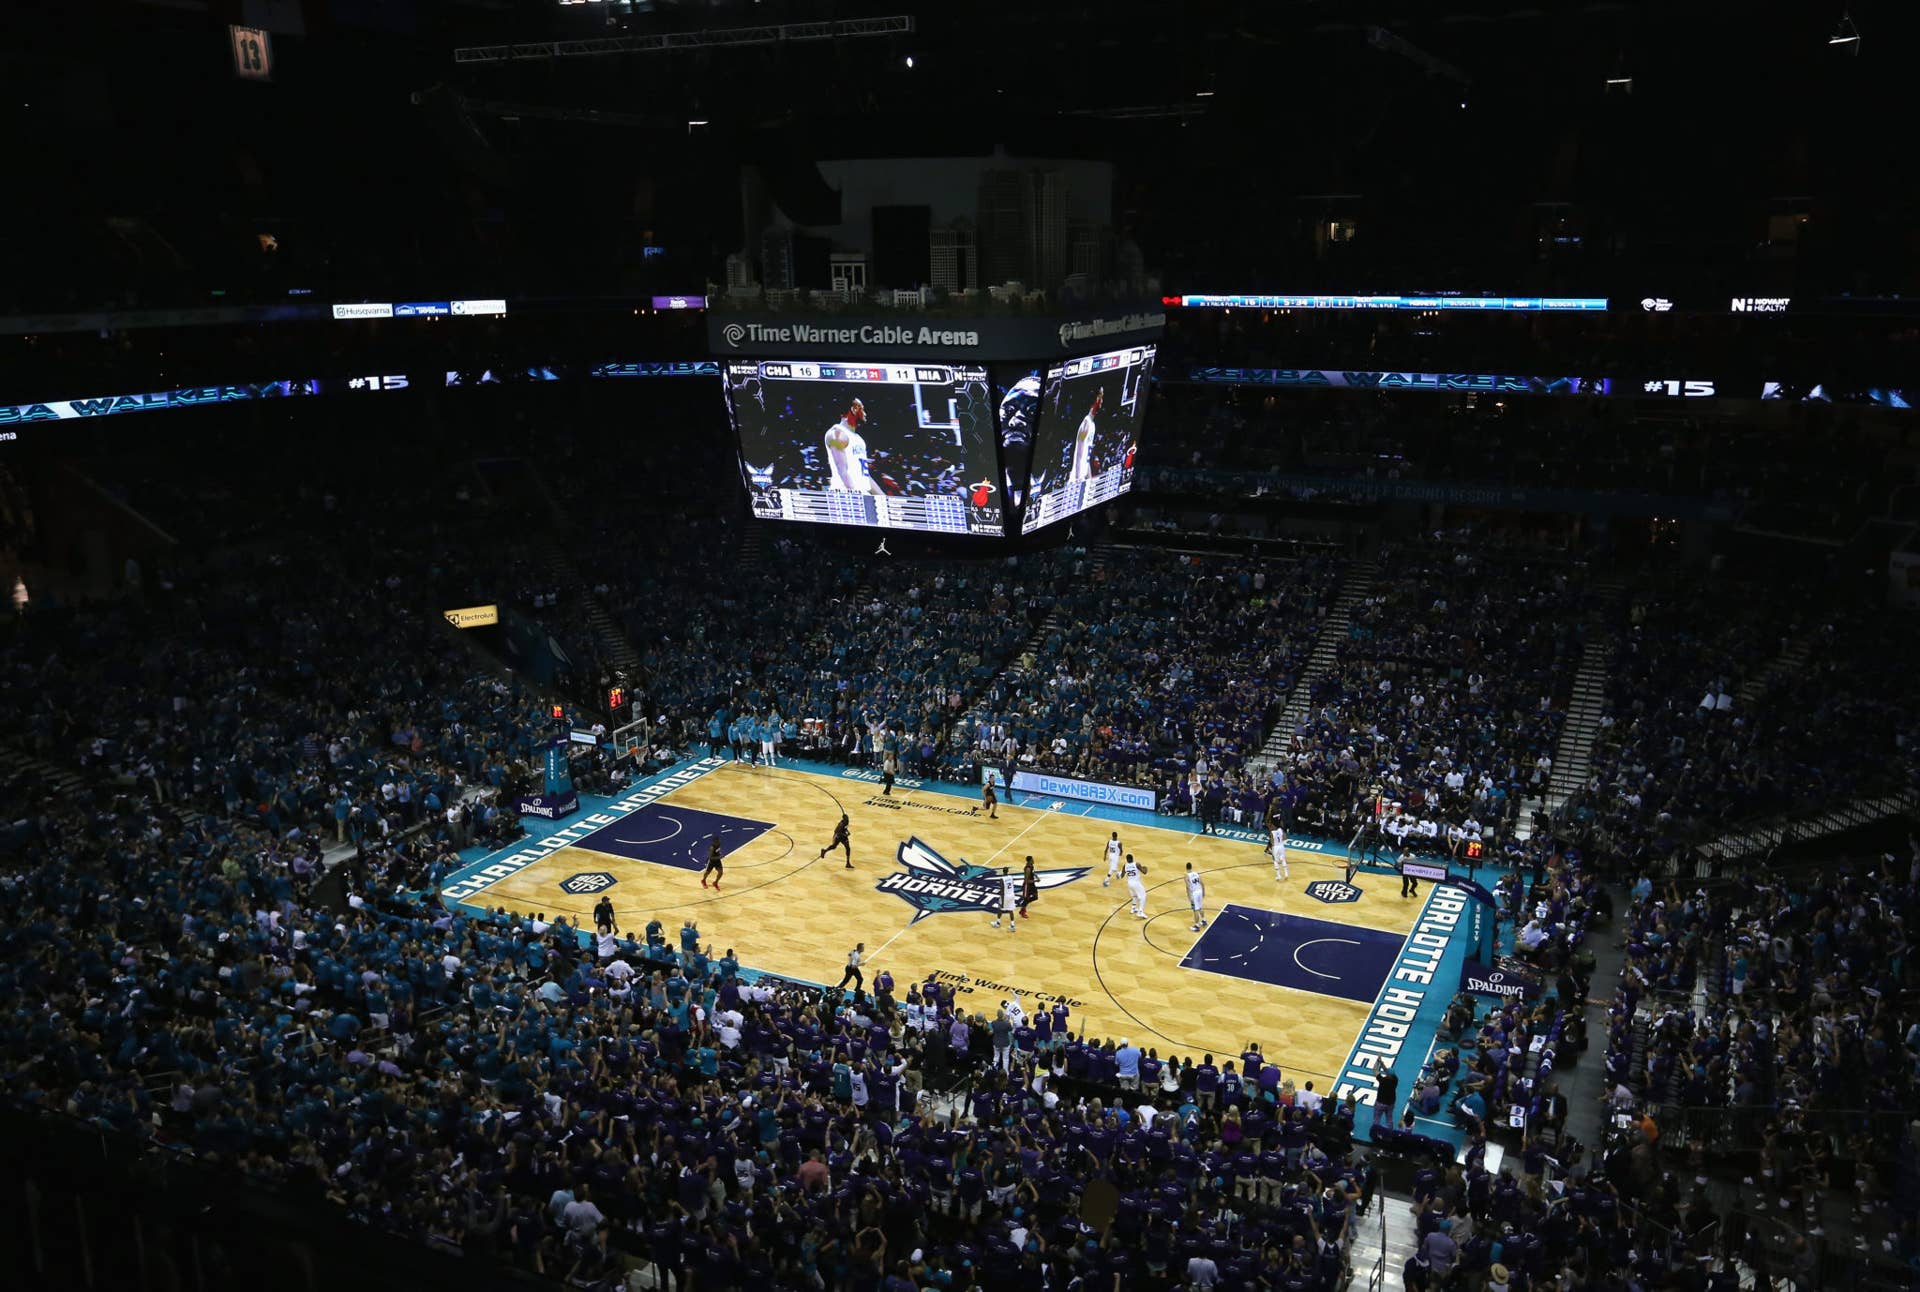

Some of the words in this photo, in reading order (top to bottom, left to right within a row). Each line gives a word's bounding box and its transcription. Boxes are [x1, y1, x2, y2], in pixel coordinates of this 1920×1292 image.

[241, 39, 261, 70] 13
[346, 307, 390, 316] Husqvarna
[1754, 304, 1786, 312] HEALTH
[747, 323, 790, 343] Time
[793, 324, 858, 344] Warner
[860, 325, 913, 345] Cable
[917, 326, 979, 346] Arena
[766, 366, 791, 376] CHA
[799, 367, 812, 377] 16
[844, 369, 868, 379] 5:34
[869, 371, 879, 379] 21
[896, 370, 909, 379] 11
[917, 369, 941, 381] MIA
[1191, 367, 1329, 384] KEMBA
[1343, 371, 1530, 392] WALKER
[349, 375, 409, 390] #15
[1644, 380, 1715, 397] #15
[70, 386, 250, 417] WALKER
[460, 612, 495, 622] Electrolux
[610, 694, 621, 707] 21
[610, 757, 728, 813] HORNETS
[1039, 776, 1150, 806] DewNBA3X.com
[520, 802, 553, 818] SPALDING
[863, 799, 902, 811] Arena
[871, 795, 900, 805] Time
[902, 800, 945, 813] Warner
[442, 812, 617, 900] CHARLOTTE
[1314, 890, 1350, 901] CITY
[1315, 882, 1355, 896] BUZZ
[1394, 886, 1469, 985] HARLOTTE
[1467, 977, 1524, 999] SPALDING
[1035, 991, 1082, 1008] Cale
[1011, 1006, 1021, 1016] 15
